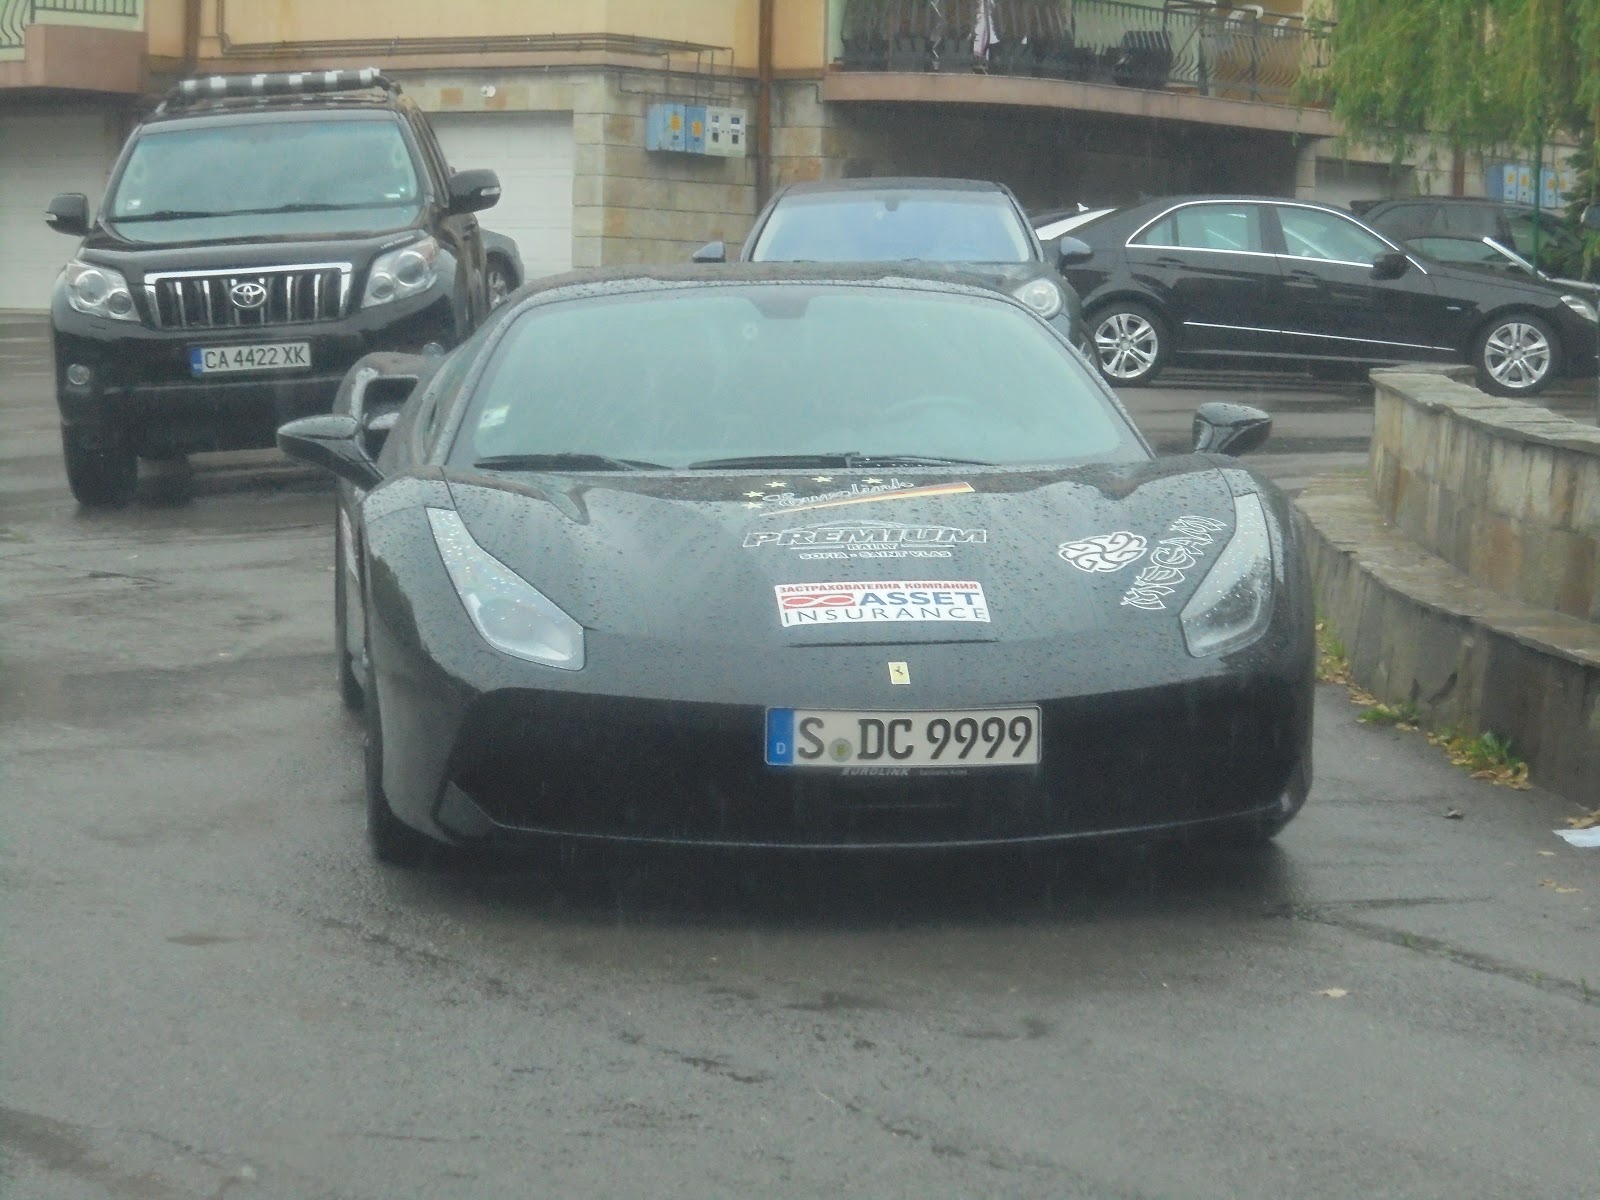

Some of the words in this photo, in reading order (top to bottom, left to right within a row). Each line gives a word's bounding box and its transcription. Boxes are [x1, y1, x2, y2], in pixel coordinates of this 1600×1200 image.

[205, 351, 229, 369] CA
[233, 348, 279, 367] 4422
[282, 345, 306, 365] XK
[743, 528, 988, 548] PREMIUM
[799, 551, 849, 560] SOFIA
[846, 543, 899, 551] RALLY
[779, 582, 900, 594] ЗАСТРАХОВАТЕЛНА
[904, 581, 978, 591] КОМПАНИЯ
[859, 591, 980, 606] ASSET
[784, 606, 987, 625] INSURANCE
[775, 742, 786, 755] D
[797, 716, 825, 760] S
[857, 718, 914, 760] DC
[926, 715, 1033, 760] 9999
